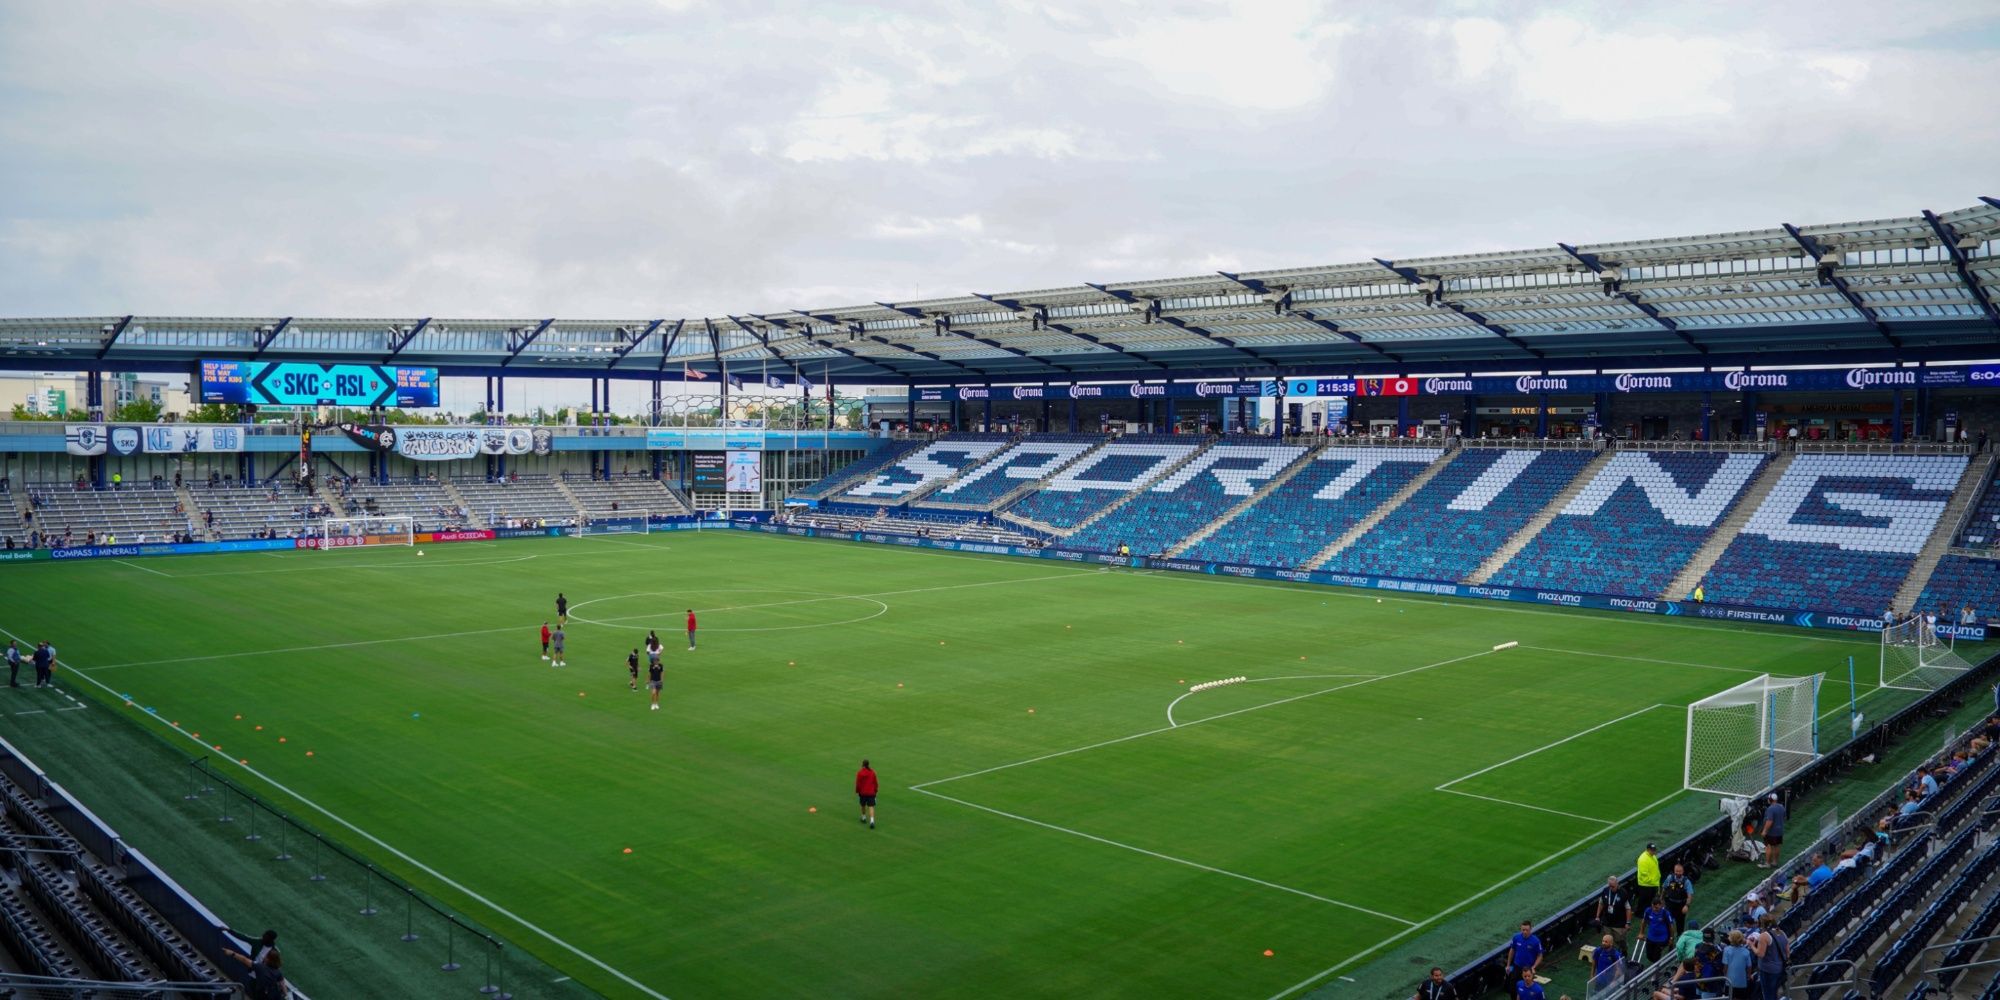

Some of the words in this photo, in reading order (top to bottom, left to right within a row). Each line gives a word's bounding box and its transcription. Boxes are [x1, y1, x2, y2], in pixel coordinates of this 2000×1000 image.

[284, 373, 319, 396] SKC
[336, 374, 366, 396] RSL
[1516, 376, 1568, 394] Corona
[1614, 374, 1672, 392] Corona
[1724, 371, 1788, 391] Corona
[1846, 368, 1916, 389] Corona
[959, 387, 988, 400] Corona
[1013, 386, 1042, 400] Corona
[1070, 384, 1102, 399] Corona
[1130, 383, 1165, 398] Corona
[1196, 382, 1232, 398] Corona
[1425, 378, 1472, 395] Corona
[146, 428, 173, 450] KC
[212, 428, 237, 450] 96
[352, 425, 379, 440] LOVE
[402, 438, 478, 455] CAULDRON
[848, 441, 1969, 554] SPORTING
[52, 549, 93, 558] COMPASS
[99, 548, 138, 556] MINERALS
[1056, 550, 1082, 559] mazuma
[1098, 554, 1126, 564] mazuma
[1223, 566, 1256, 575] mazuma
[1276, 570, 1310, 580] mazuma
[1332, 574, 1368, 584] mazuma
[1431, 584, 1456, 594] PARTNER
[1469, 586, 1510, 597] mazuma
[1537, 592, 1580, 603] mazuma
[1610, 598, 1656, 609] mazuma
[1826, 616, 1883, 628] mazuma
[1936, 625, 1984, 636] azuma
